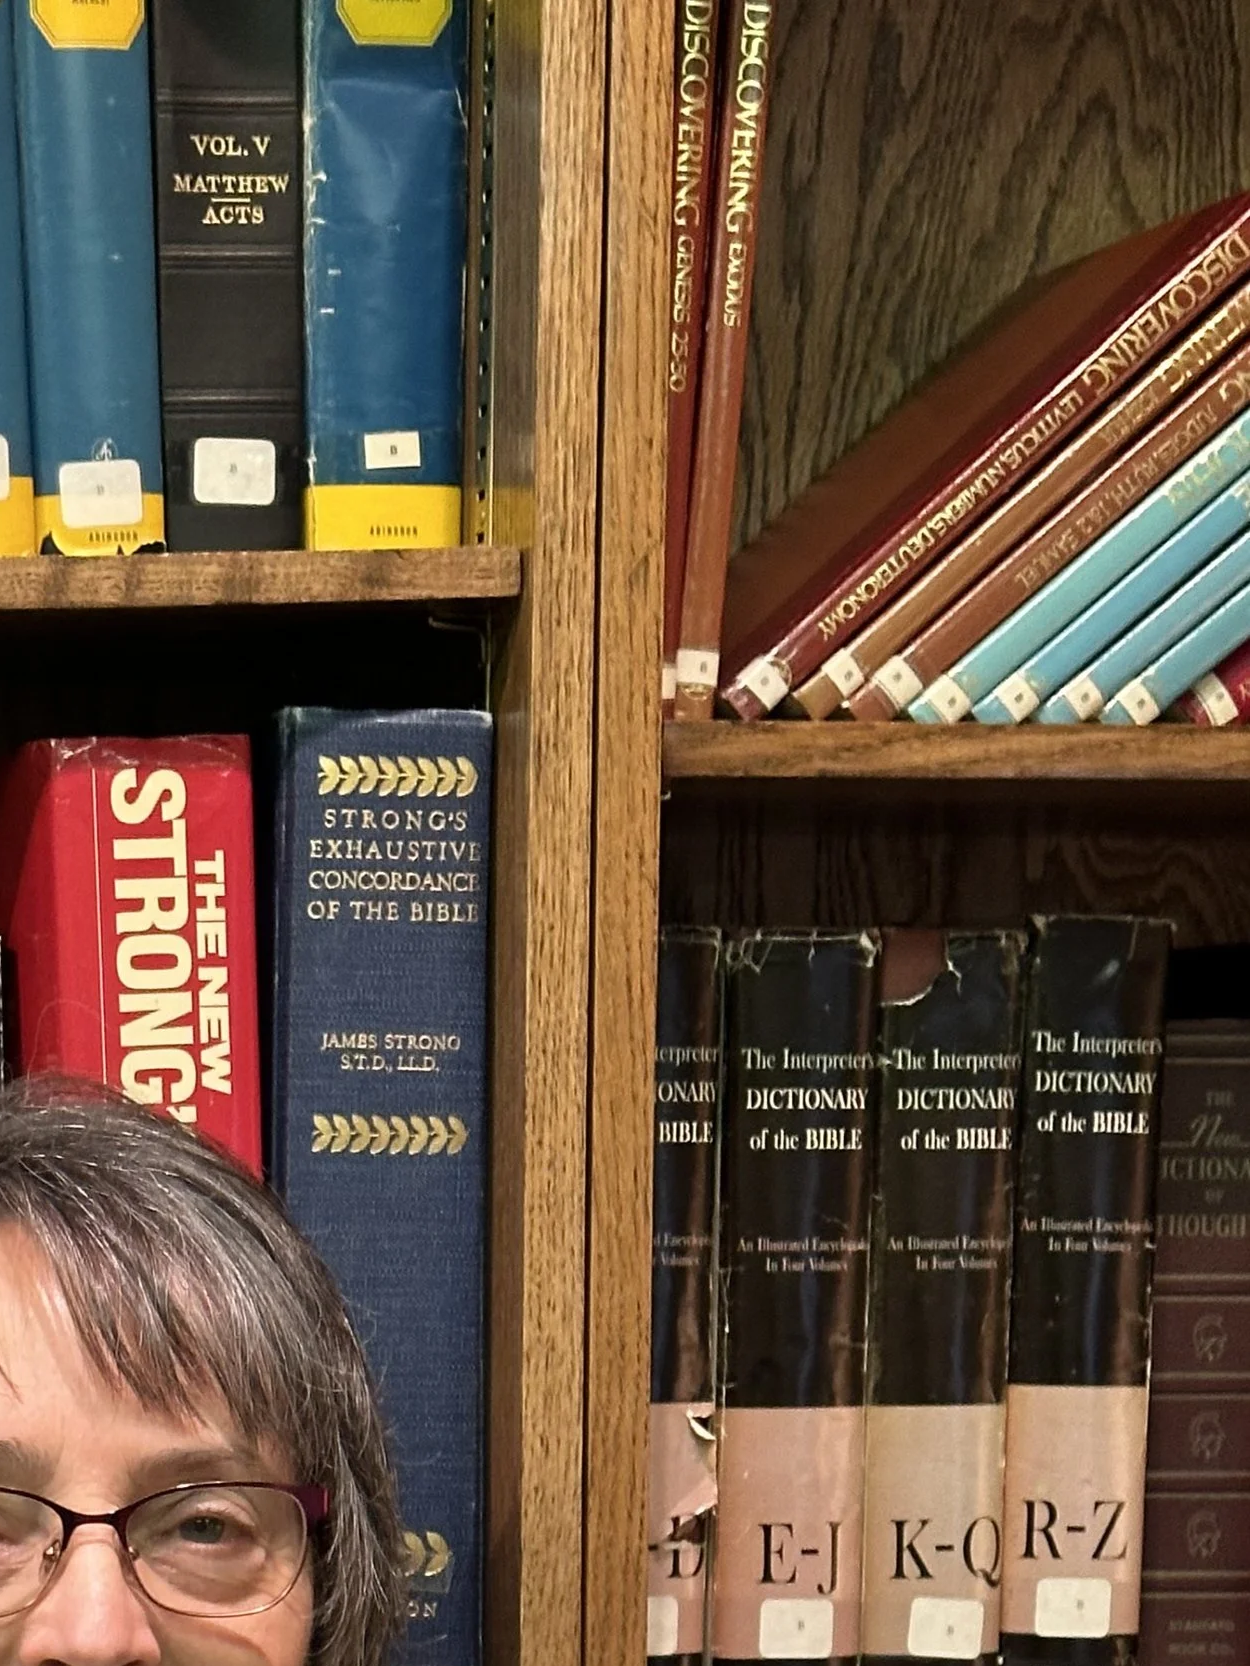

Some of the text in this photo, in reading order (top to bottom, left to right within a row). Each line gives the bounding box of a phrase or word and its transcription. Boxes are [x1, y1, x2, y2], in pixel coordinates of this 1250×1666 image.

[674, 0, 713, 228] DISCOVERING
[190, 134, 271, 157] VOL. V
[723, 0, 772, 328] DISCOVERING EXODUS
[173, 174, 289, 195] MATTHEW
[202, 206, 264, 225] ACTS
[673, 234, 696, 324] GENESIS
[1082, 230, 1250, 396] DISCOVERING
[324, 808, 468, 831] STRONG'S
[310, 840, 481, 862] EXHAUSTIVE
[308, 871, 480, 893] CONCORDANCE
[307, 901, 479, 923] OF THE BIBLE
[193, 849, 233, 1095] THE NEW
[321, 1033, 461, 1053] JAMES STRONG
[1031, 1029, 1066, 1053] The
[741, 1047, 776, 1070] The
[893, 1047, 926, 1071] The
[1035, 1070, 1157, 1095] DICTIONARY
[746, 1087, 869, 1111] DICTIONARY
[897, 1087, 1018, 1110] DICTIONARY
[659, 1120, 713, 1144] BIBLE
[1037, 1110, 1150, 1135] of the BIBLE
[750, 1127, 863, 1151] of the BIBLE
[901, 1127, 1012, 1151] of the BIBLE
[1023, 1499, 1128, 1563] R-Z
[758, 1520, 843, 1595] E-J
[891, 1515, 1001, 1589] K-Q
